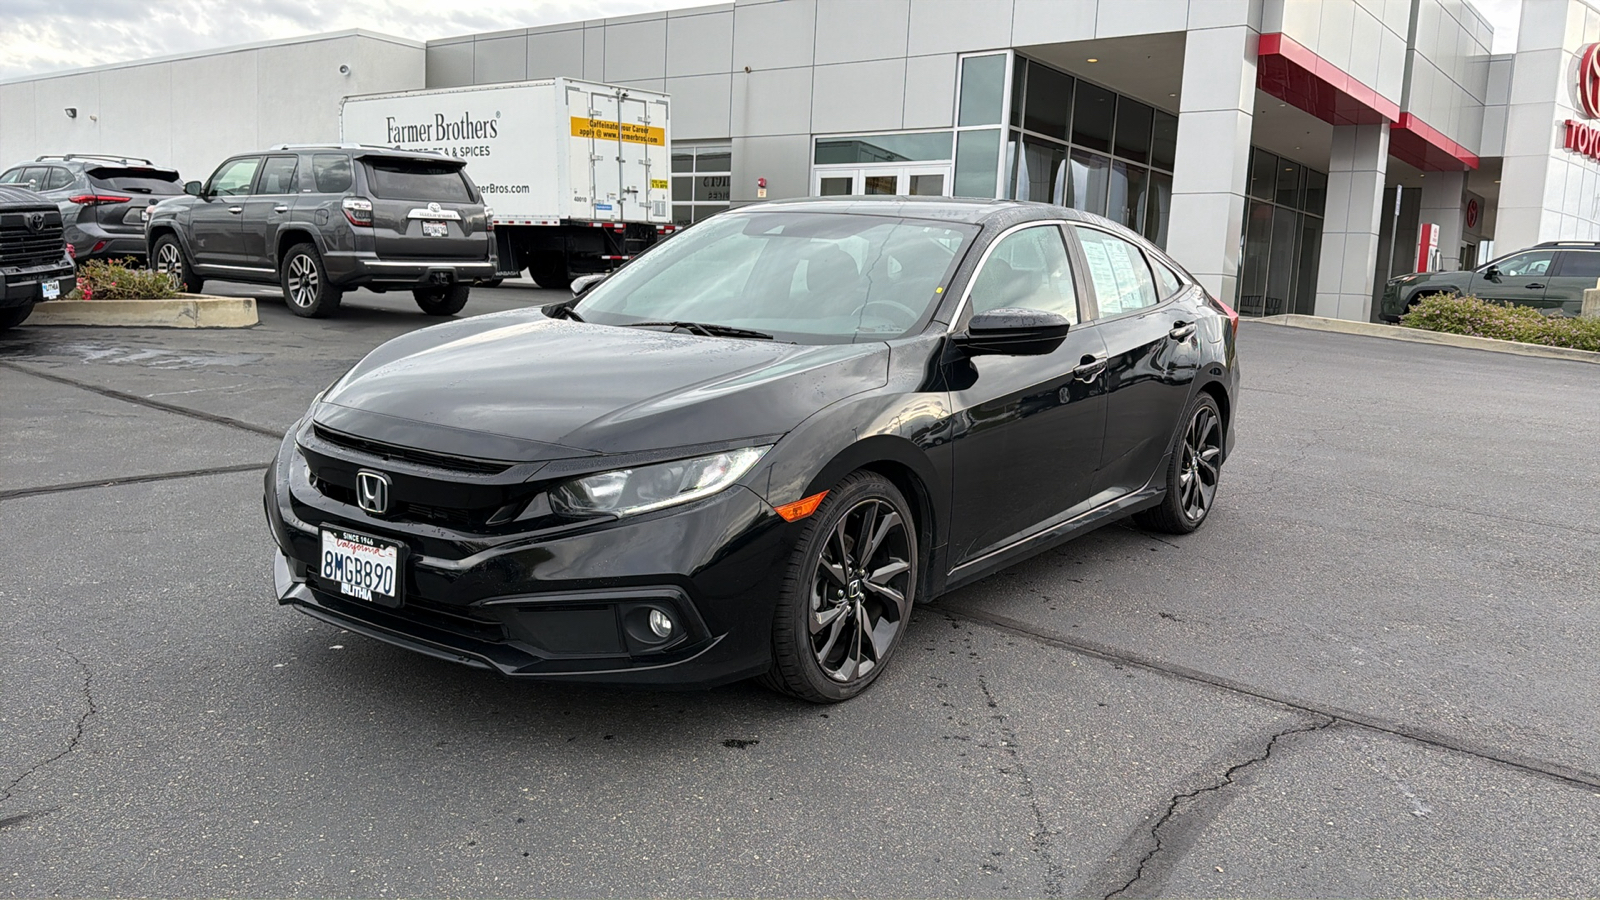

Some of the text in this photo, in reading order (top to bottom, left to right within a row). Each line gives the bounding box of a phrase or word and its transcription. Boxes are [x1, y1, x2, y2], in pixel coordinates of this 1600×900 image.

[386, 116, 432, 143] Farmer
[589, 120, 618, 130] Caffeinate
[579, 128, 595, 138] apply
[603, 132, 658, 143] www.armerbros.com
[460, 146, 490, 157] SPICES
[342, 532, 374, 546] SINCE 1946
[336, 539, 385, 557] California
[323, 550, 393, 594] 8MGB890
[349, 585, 373, 601] LITHIA
